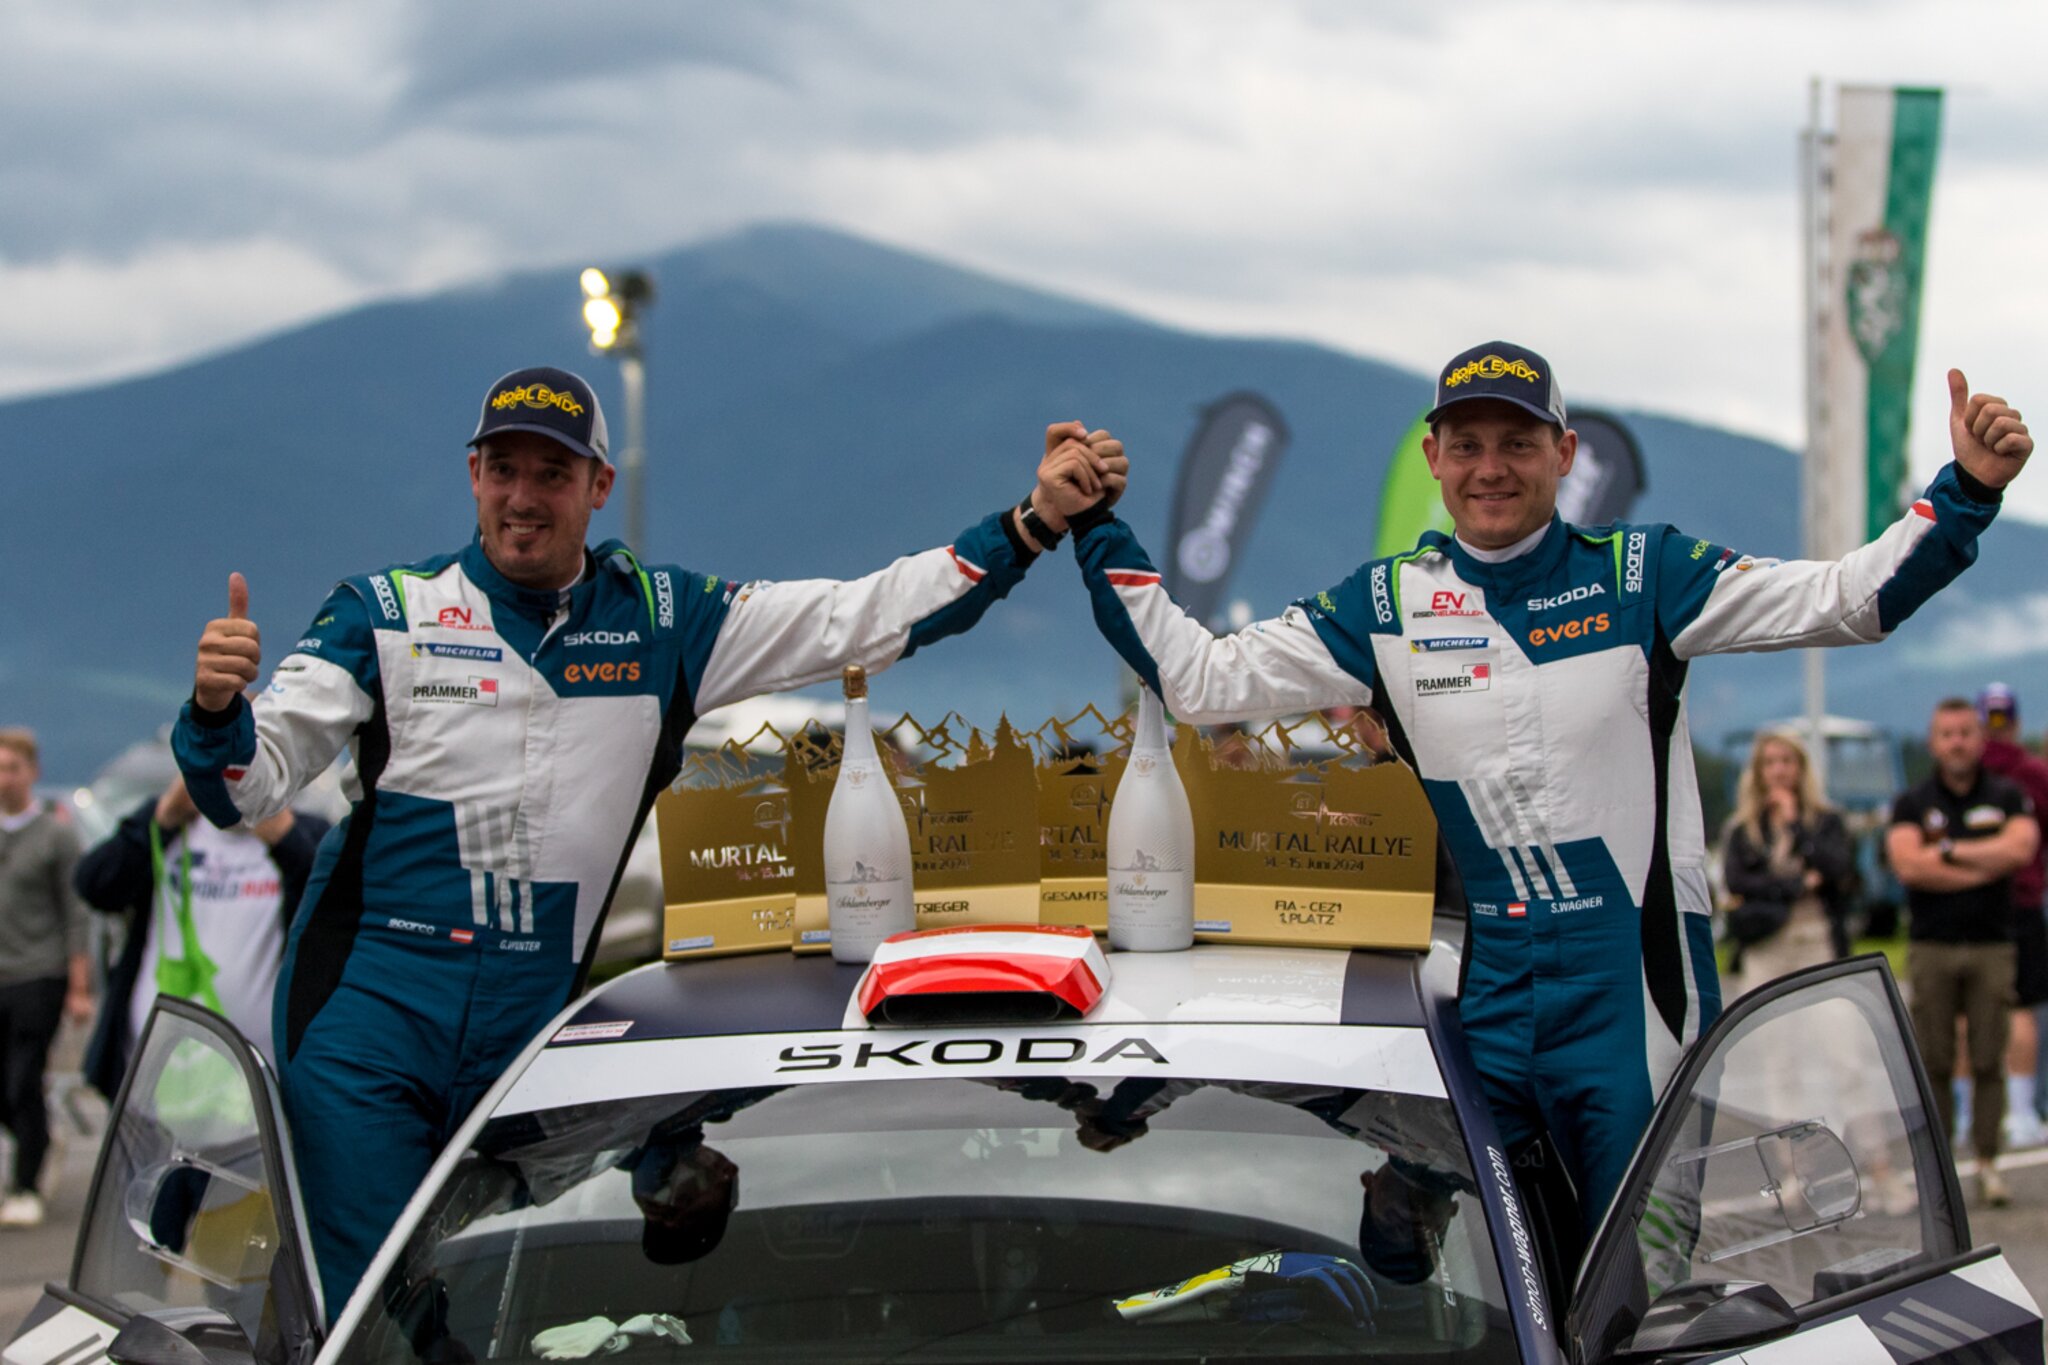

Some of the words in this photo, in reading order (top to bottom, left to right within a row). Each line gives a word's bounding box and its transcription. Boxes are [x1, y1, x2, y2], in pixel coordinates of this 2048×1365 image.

[1625, 532, 1646, 593] sparco
[369, 575, 400, 620] sparco
[654, 571, 674, 629] sparco
[1370, 564, 1393, 625] sparco
[1527, 583, 1605, 611] SKODA
[563, 630, 641, 646] SKODA
[1529, 613, 1610, 646] evers
[433, 645, 498, 659] MICHELIN
[1430, 638, 1485, 649] MICHELIN
[564, 662, 640, 683] evers
[413, 685, 478, 699] PRAMMER
[1416, 676, 1471, 691] PRAMMER
[1040, 825, 1100, 846] RTAL
[1219, 830, 1317, 855] MURTAL
[1325, 835, 1413, 858] RALLYE
[690, 843, 788, 869] MURTAL
[1042, 890, 1107, 902] GESAMTS
[1275, 900, 1297, 911] FIA
[1551, 896, 1603, 914] S.WAGNER
[914, 901, 970, 914] TSIEGER
[774, 1037, 1170, 1073] SKODA
[1486, 1145, 1547, 1331] simon-wagner.com
